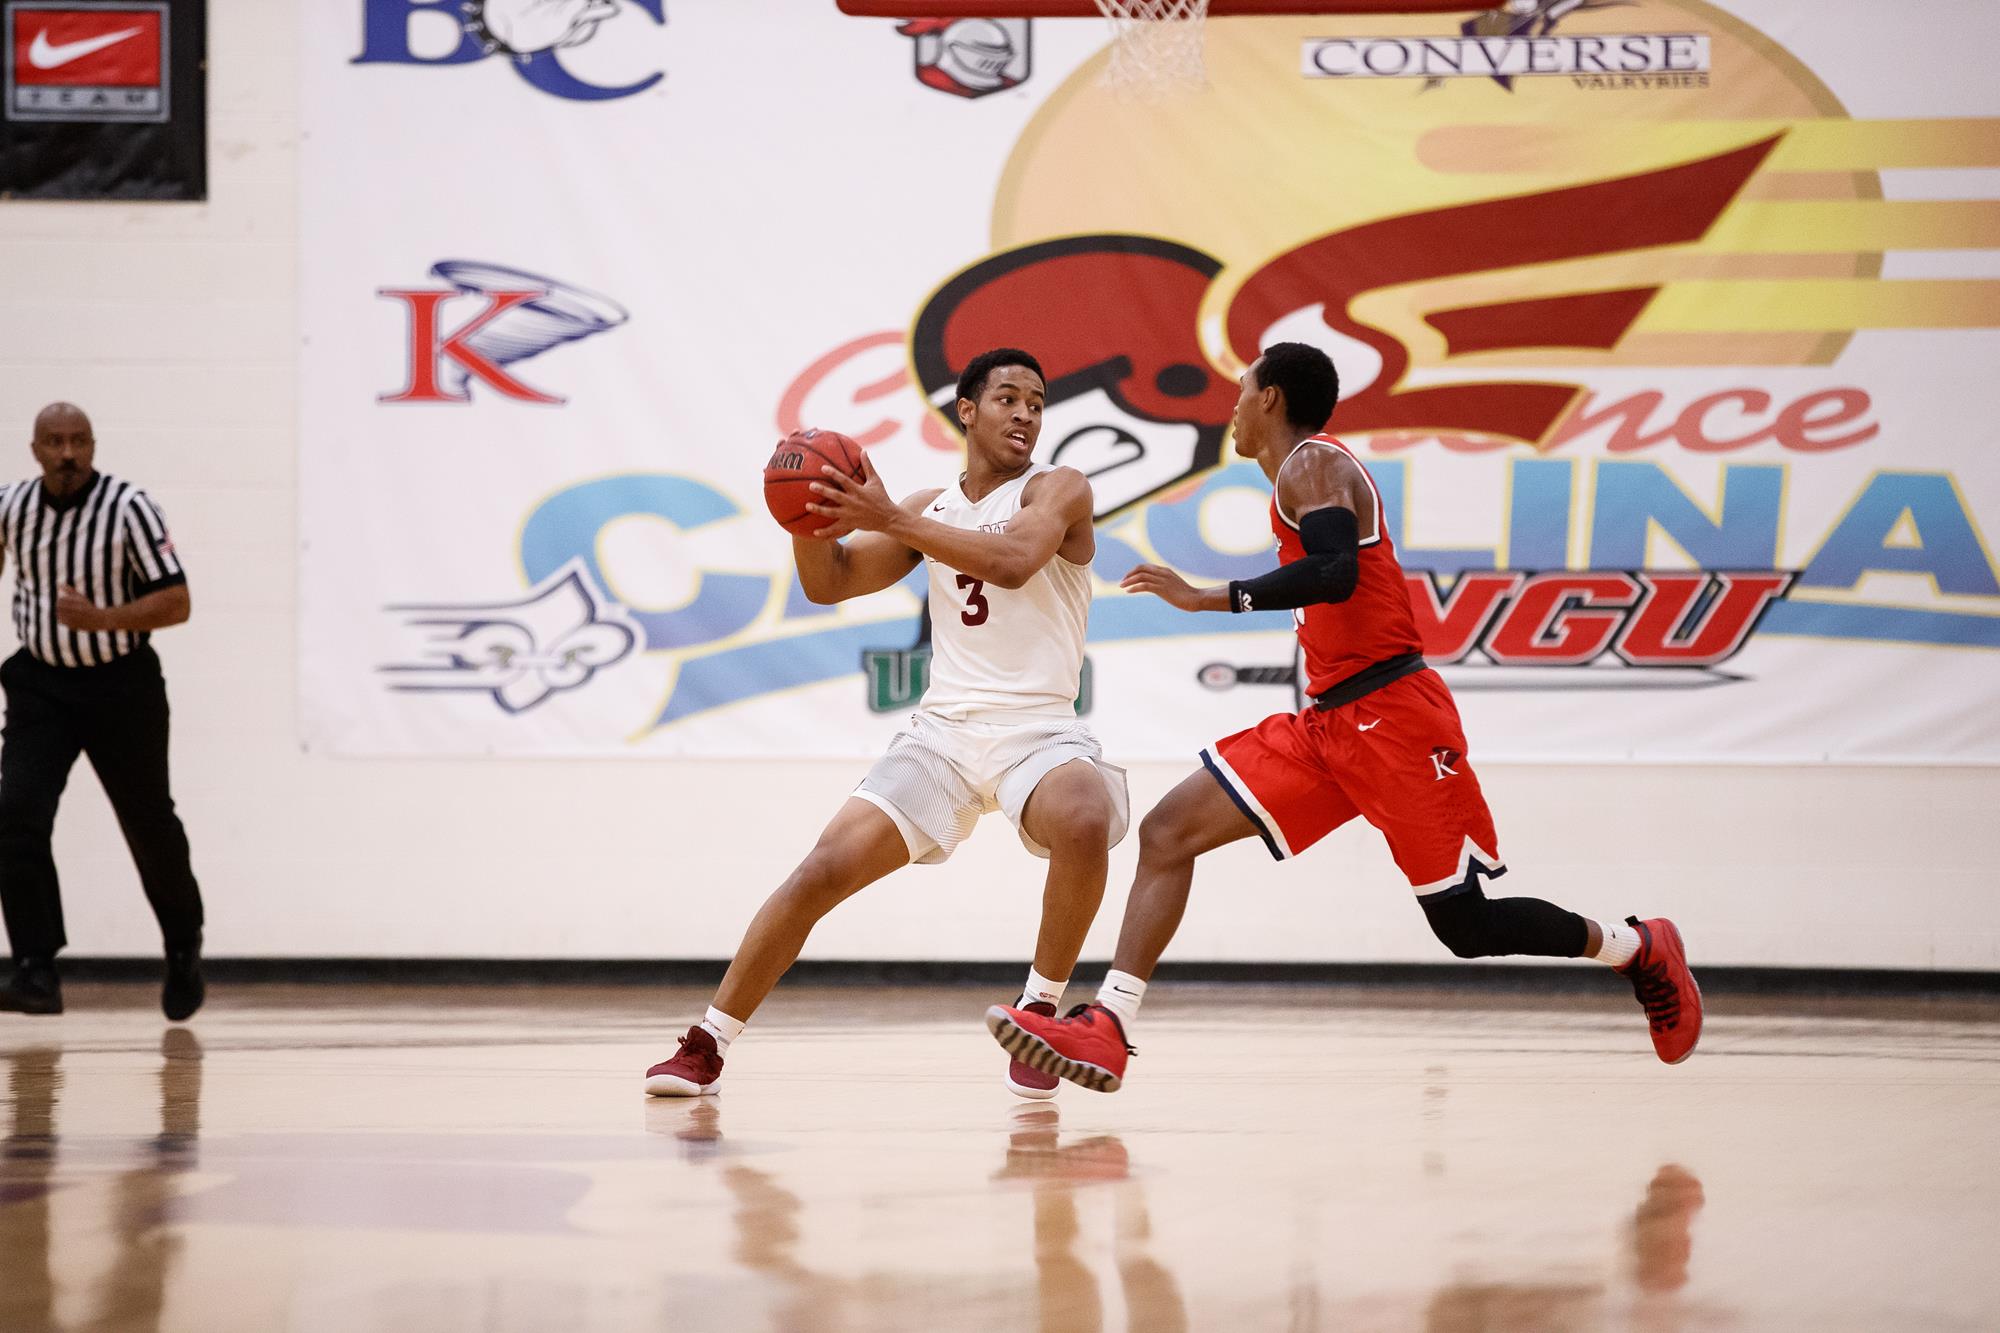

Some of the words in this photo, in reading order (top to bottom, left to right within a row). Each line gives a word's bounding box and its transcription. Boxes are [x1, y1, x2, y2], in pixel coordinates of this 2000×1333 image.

[1313, 36, 1698, 76] CONVERSE
[1573, 73, 1710, 90] VALKYRIES
[376, 289, 567, 404] K
[955, 573, 989, 627] 3
[1428, 750, 1460, 781] K
